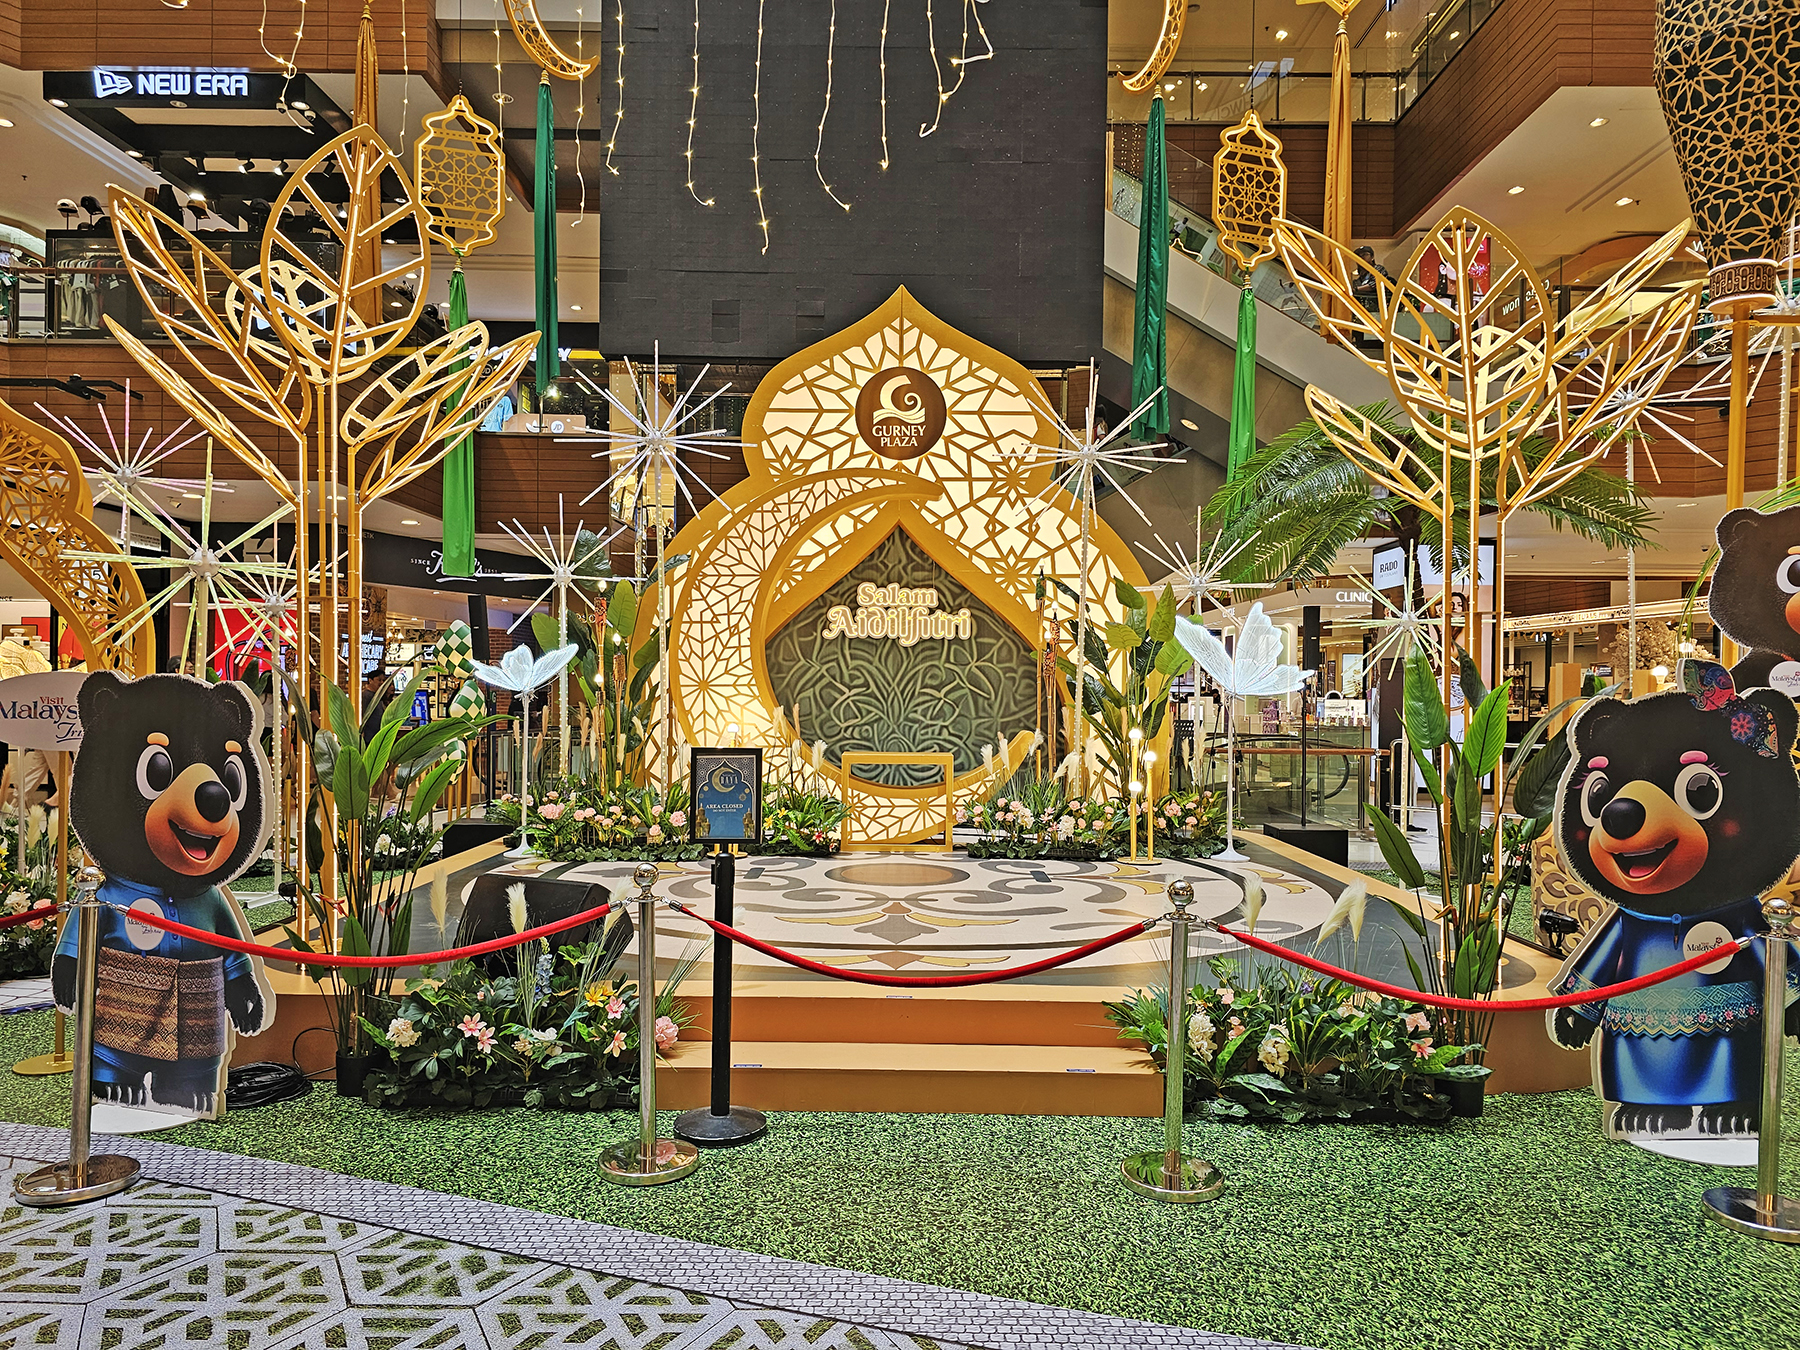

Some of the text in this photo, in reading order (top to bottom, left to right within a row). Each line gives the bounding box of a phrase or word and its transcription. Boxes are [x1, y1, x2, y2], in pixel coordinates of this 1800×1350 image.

[137, 73, 249, 96] NEW ERA
[872, 425, 926, 437] GURNEY
[880, 437, 918, 447] PLAZA
[1379, 560, 1398, 573] RADO
[857, 582, 939, 608] Salam
[1335, 591, 1373, 603] CLINIQ
[822, 605, 971, 647] Aidilfitri
[40, 696, 64, 705] Visit
[0, 700, 78, 724] Malays
